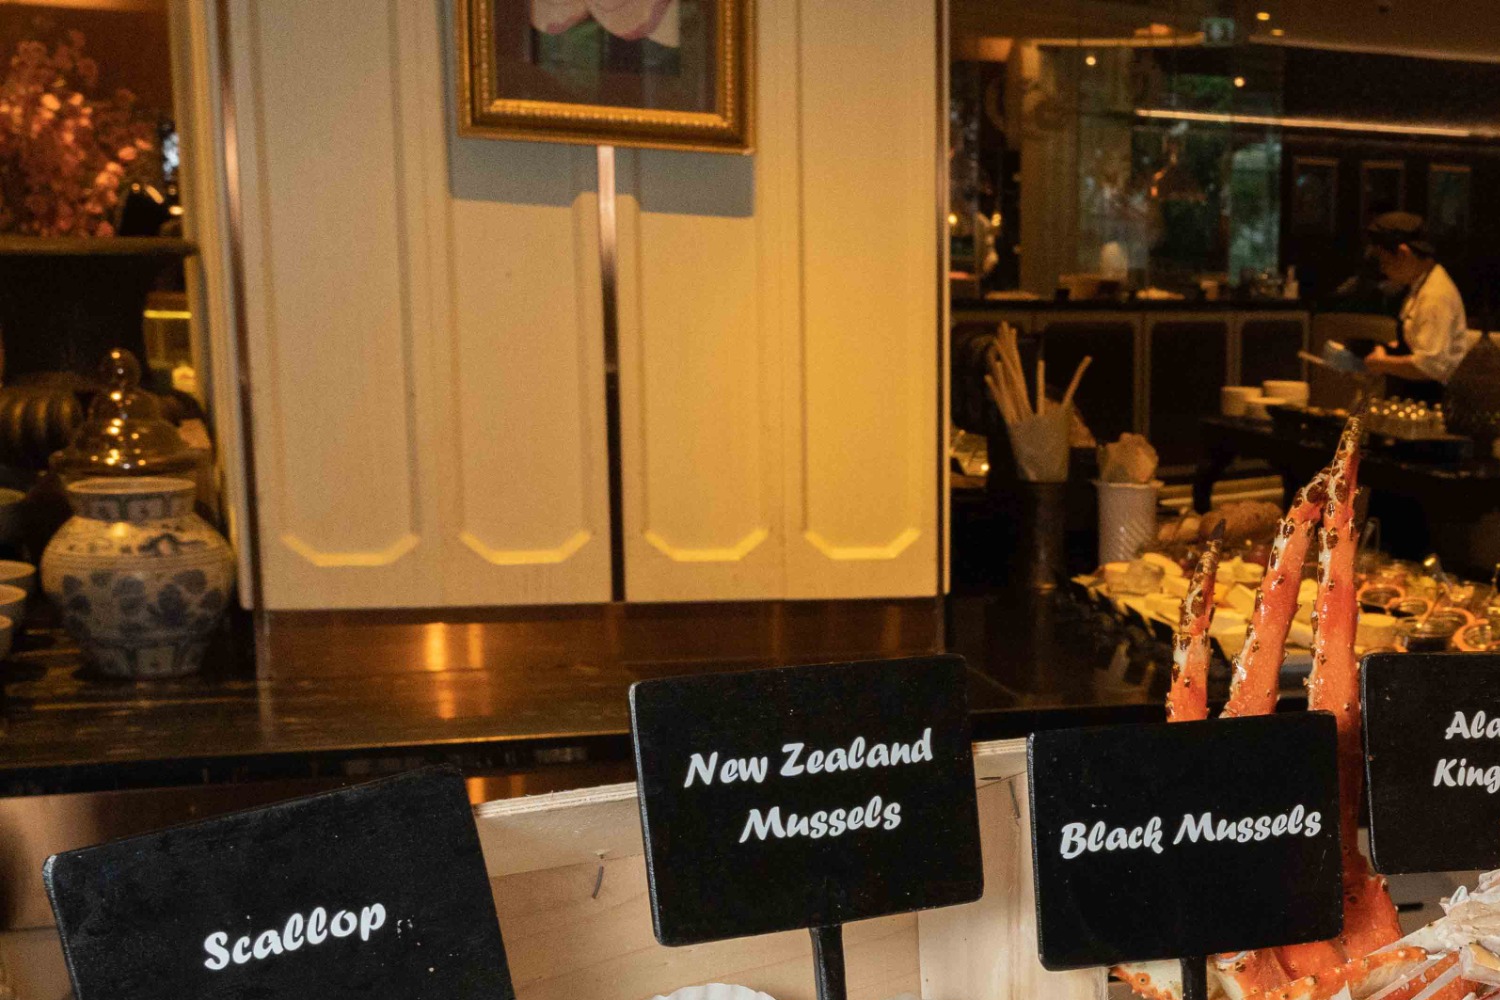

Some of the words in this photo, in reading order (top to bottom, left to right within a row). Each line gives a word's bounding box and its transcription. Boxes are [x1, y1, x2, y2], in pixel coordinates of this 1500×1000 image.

[682, 750, 767, 788] New
[778, 726, 934, 777] Zealand
[738, 795, 902, 844] Mussels
[1059, 815, 1165, 860] Black
[1172, 804, 1322, 845] Mussels
[203, 901, 388, 971] Scallop
